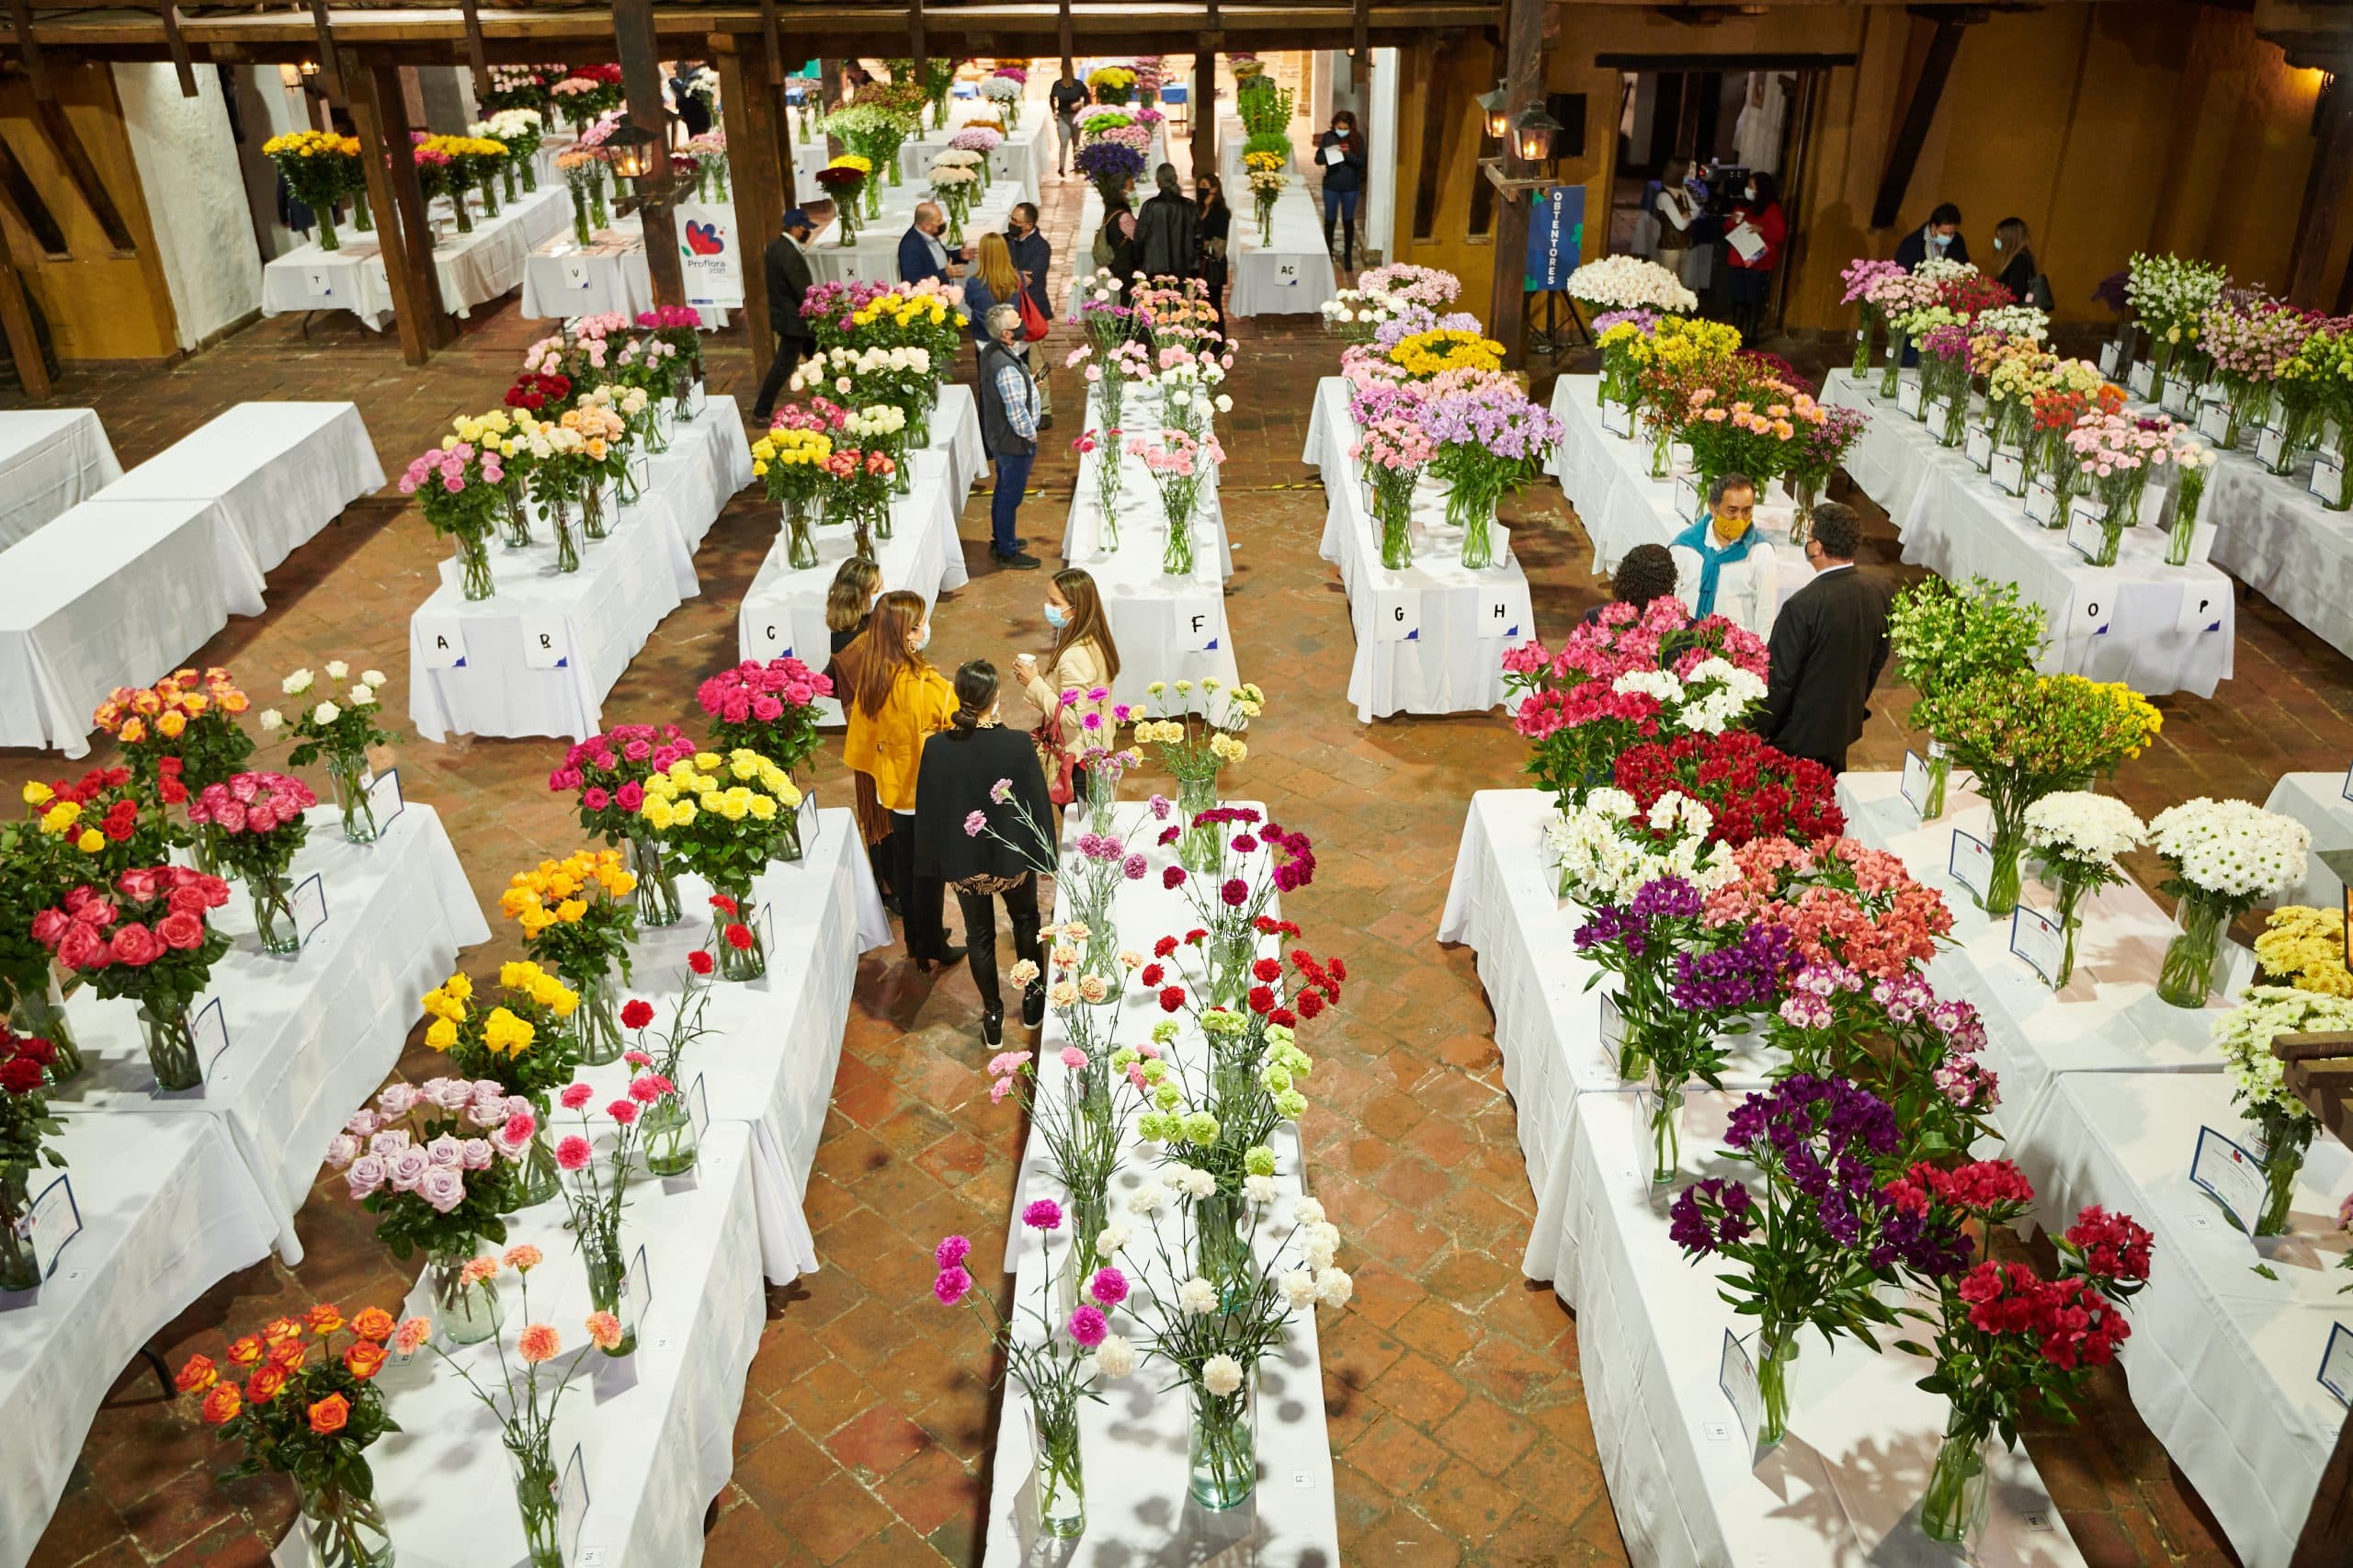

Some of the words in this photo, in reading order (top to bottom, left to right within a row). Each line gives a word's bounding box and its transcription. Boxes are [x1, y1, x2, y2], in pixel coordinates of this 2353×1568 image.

[1547, 191, 1563, 285] OBTENTORES
[688, 259, 726, 267] Proflora
[847, 267, 855, 277] X
[1280, 266, 1294, 276] AC
[313, 276, 321, 284] T
[1494, 604, 1506, 619] H
[2199, 599, 2209, 614] P
[1394, 607, 1404, 622] G
[1191, 615, 1205, 633] F
[767, 625, 776, 641] C
[437, 635, 449, 650] A
[540, 633, 551, 649] B
